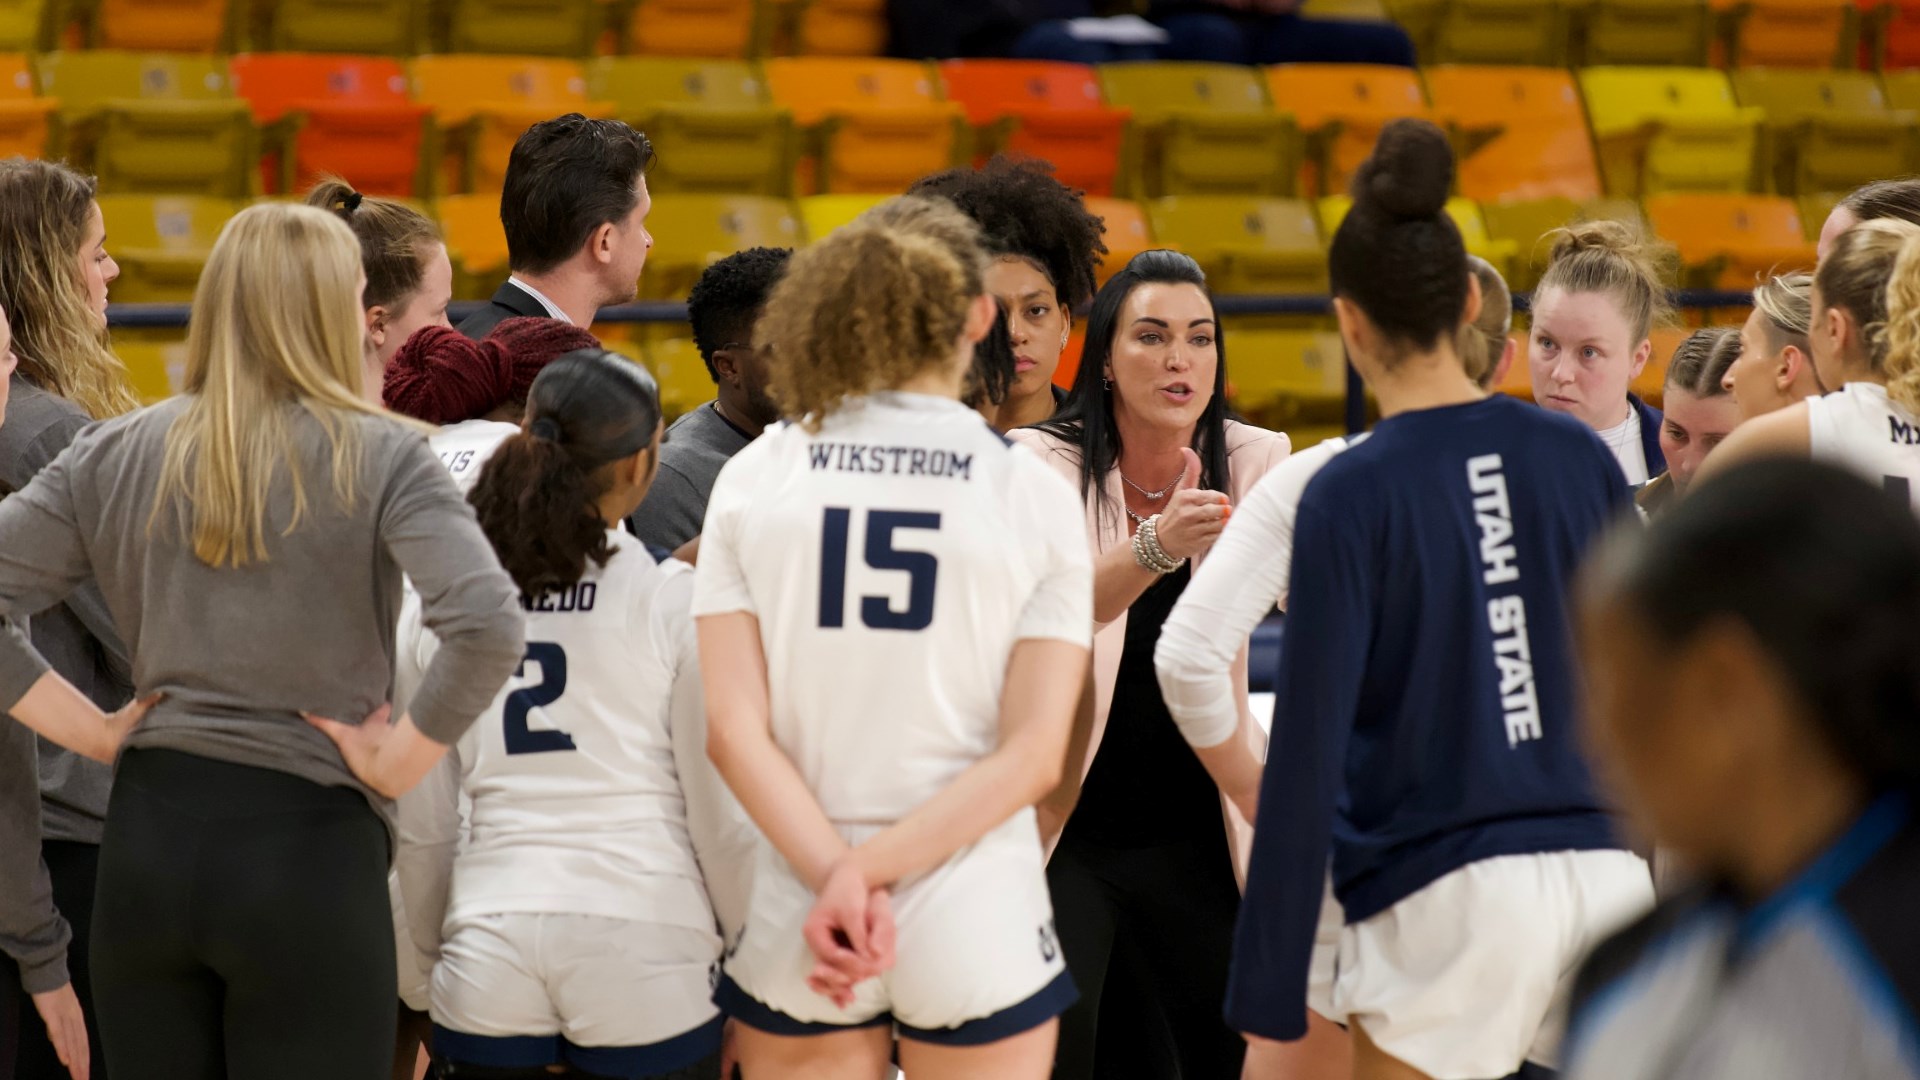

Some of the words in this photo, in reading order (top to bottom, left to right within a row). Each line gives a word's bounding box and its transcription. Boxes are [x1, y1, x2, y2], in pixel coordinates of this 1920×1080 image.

[808, 442, 974, 481] WIKSTROM
[1466, 453, 1520, 585] UTAH
[817, 506, 942, 632] 15
[502, 641, 577, 755] 2
[1487, 595, 1543, 749] STATE
